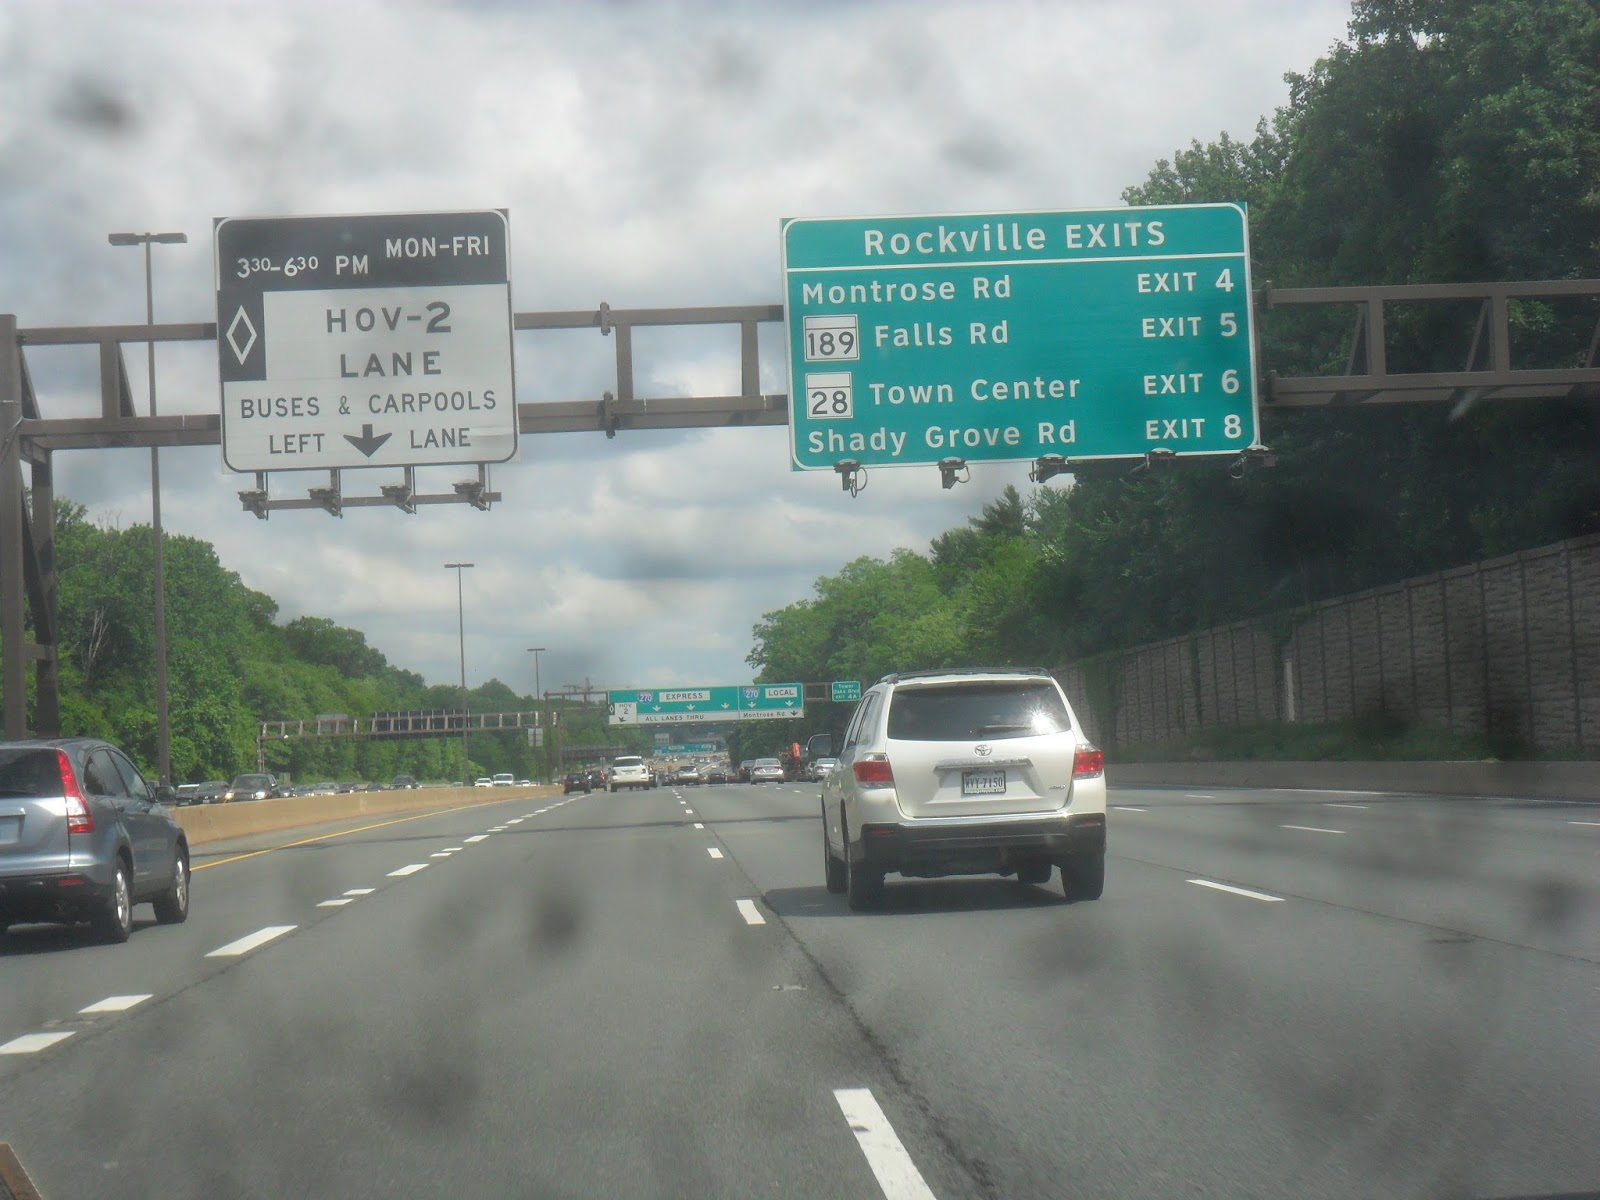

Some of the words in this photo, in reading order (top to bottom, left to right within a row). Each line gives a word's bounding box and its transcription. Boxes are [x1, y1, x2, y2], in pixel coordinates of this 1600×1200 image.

[386, 236, 489, 258] MON-FRI
[864, 223, 1046, 256] Rockville
[1066, 221, 1166, 249] EXITS
[335, 255, 369, 275] PM
[802, 278, 956, 305] Montrose
[973, 274, 1011, 299] Rd
[1137, 271, 1197, 293] EXIT
[1214, 268, 1235, 293] 4
[326, 301, 451, 334] HOV-2
[875, 321, 953, 348] Falls
[969, 320, 1009, 344] Rd
[1141, 316, 1202, 339] EXIT
[1219, 312, 1237, 337] 5
[807, 331, 855, 358] 189
[340, 351, 442, 378] LANE
[869, 382, 954, 405] Town
[971, 378, 1081, 401] Center
[1143, 373, 1203, 395] EXIT
[1221, 369, 1240, 394] 6
[241, 396, 320, 419] BUSES
[338, 395, 351, 415] &
[368, 390, 496, 414] CARPOOLS
[811, 389, 848, 415] 28
[269, 433, 325, 454] LEFT
[410, 427, 471, 449] LANE
[808, 425, 907, 456] Shady
[925, 422, 1020, 448] Grove
[1038, 420, 1076, 444] Rd
[1146, 418, 1206, 440] EXIT
[1223, 414, 1242, 439] 8
[746, 689, 759, 698] 270
